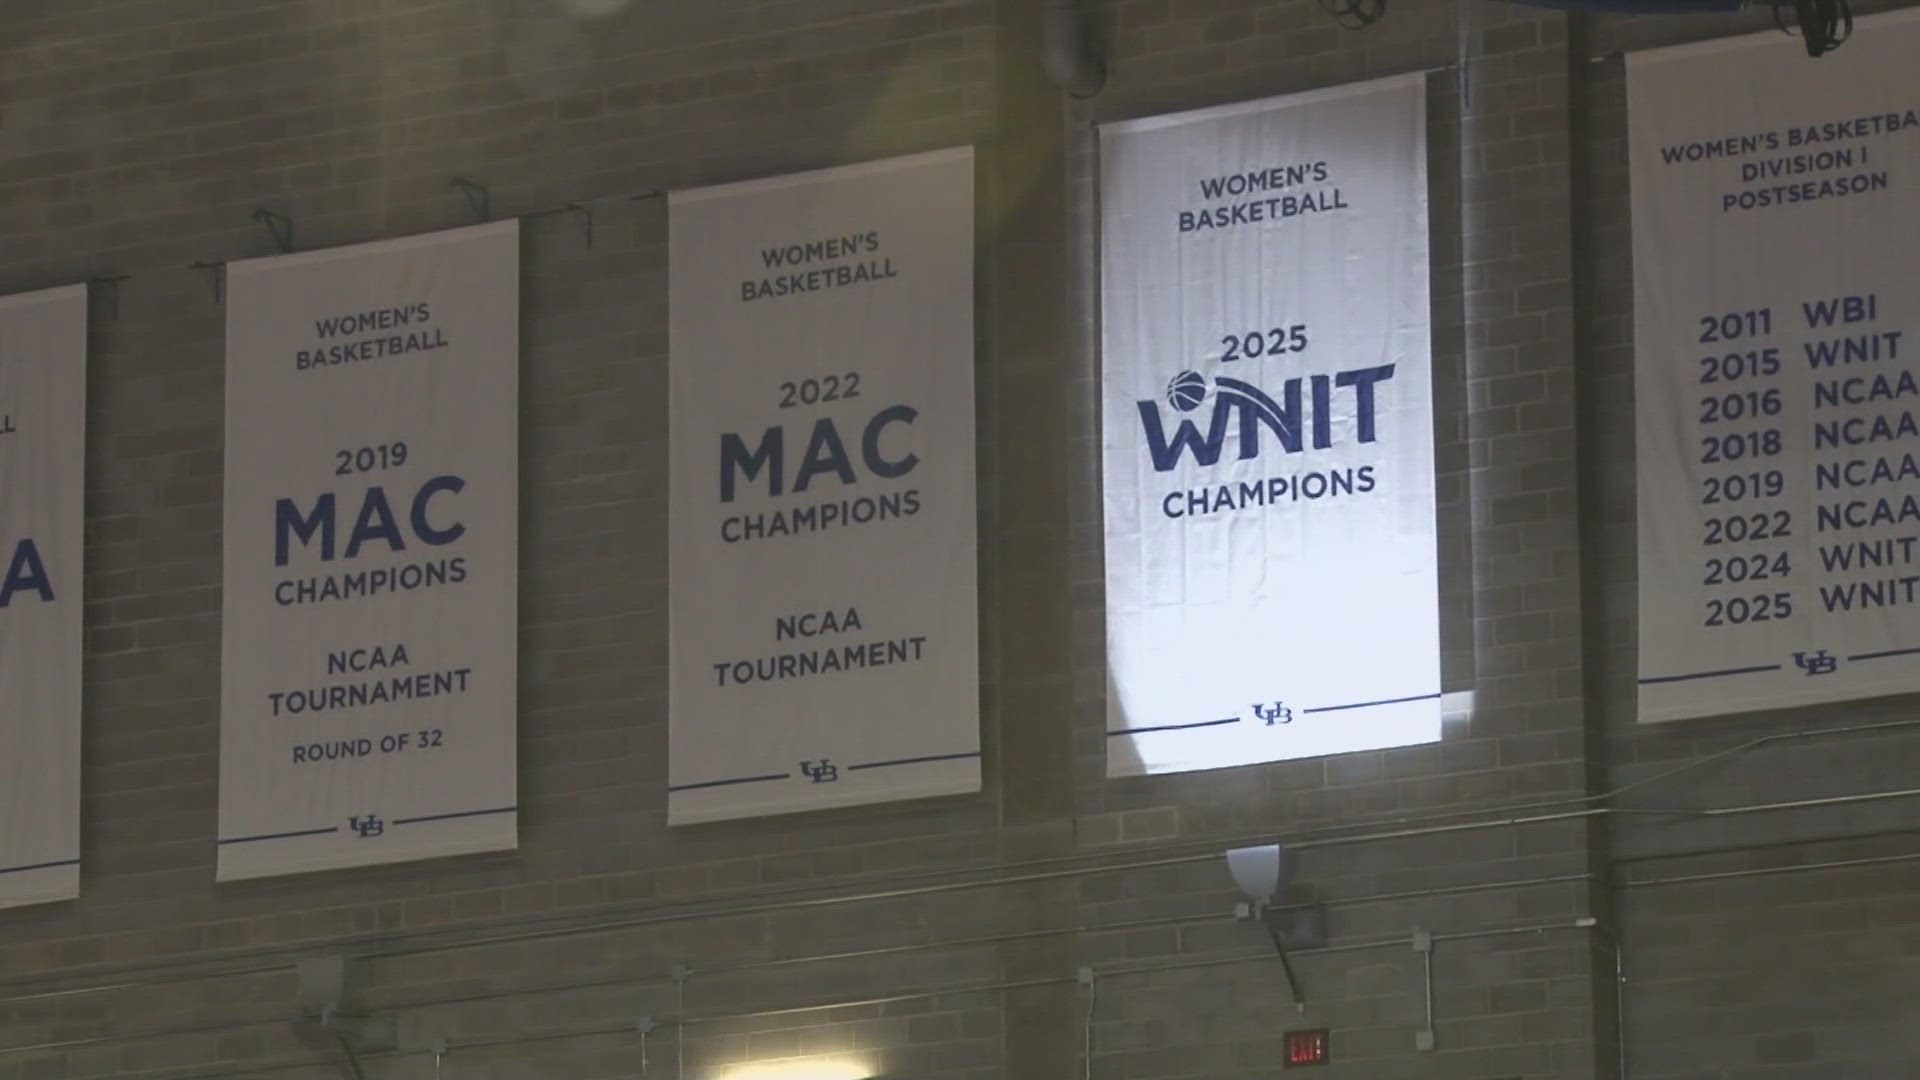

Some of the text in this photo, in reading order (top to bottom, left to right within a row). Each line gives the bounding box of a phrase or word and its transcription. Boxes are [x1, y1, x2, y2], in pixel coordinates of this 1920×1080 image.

[1660, 130, 1780, 166] WOMEN'S
[1740, 146, 1869, 182] DIVISION I
[1199, 160, 1329, 201] WOMEN'S
[1721, 172, 1889, 213] POSTSEASON
[1177, 188, 1349, 233] BASKETBALL
[760, 231, 880, 269] WOMEN'S
[740, 257, 898, 301] BASKETBALL
[314, 302, 431, 339] WOMEN'S
[1698, 293, 1878, 344] 2011 WBI
[295, 328, 450, 371] BASKETBALL
[1219, 325, 1309, 363] 2025
[1698, 330, 1903, 384] 2015 WNIT
[778, 371, 861, 409] 2022
[1698, 368, 1920, 424] 2016 NCAA
[1136, 362, 1397, 473] WNIT
[1699, 409, 1920, 464] 2018 NCAA
[334, 440, 409, 476] 2019
[718, 403, 921, 504] MAC
[1161, 465, 1377, 519] CHAMPIONS
[1700, 450, 1920, 505] 2019 NCAA
[272, 474, 468, 567] MAC
[719, 488, 922, 544] CHAMPIONS
[1702, 491, 1920, 546] 2022 NCAA
[273, 556, 468, 607] CHAMPIONS
[1702, 534, 1919, 586] 2024 WNIT
[774, 606, 863, 642] NCAA
[1703, 574, 1920, 628] 2025 WNIT
[326, 643, 410, 675] NCAA
[712, 635, 927, 688] TOURNAMENT
[267, 667, 472, 717] TOURNAMENT
[292, 728, 445, 764] ROUND OF 32
[1290, 1034, 1324, 1062] EXIT
